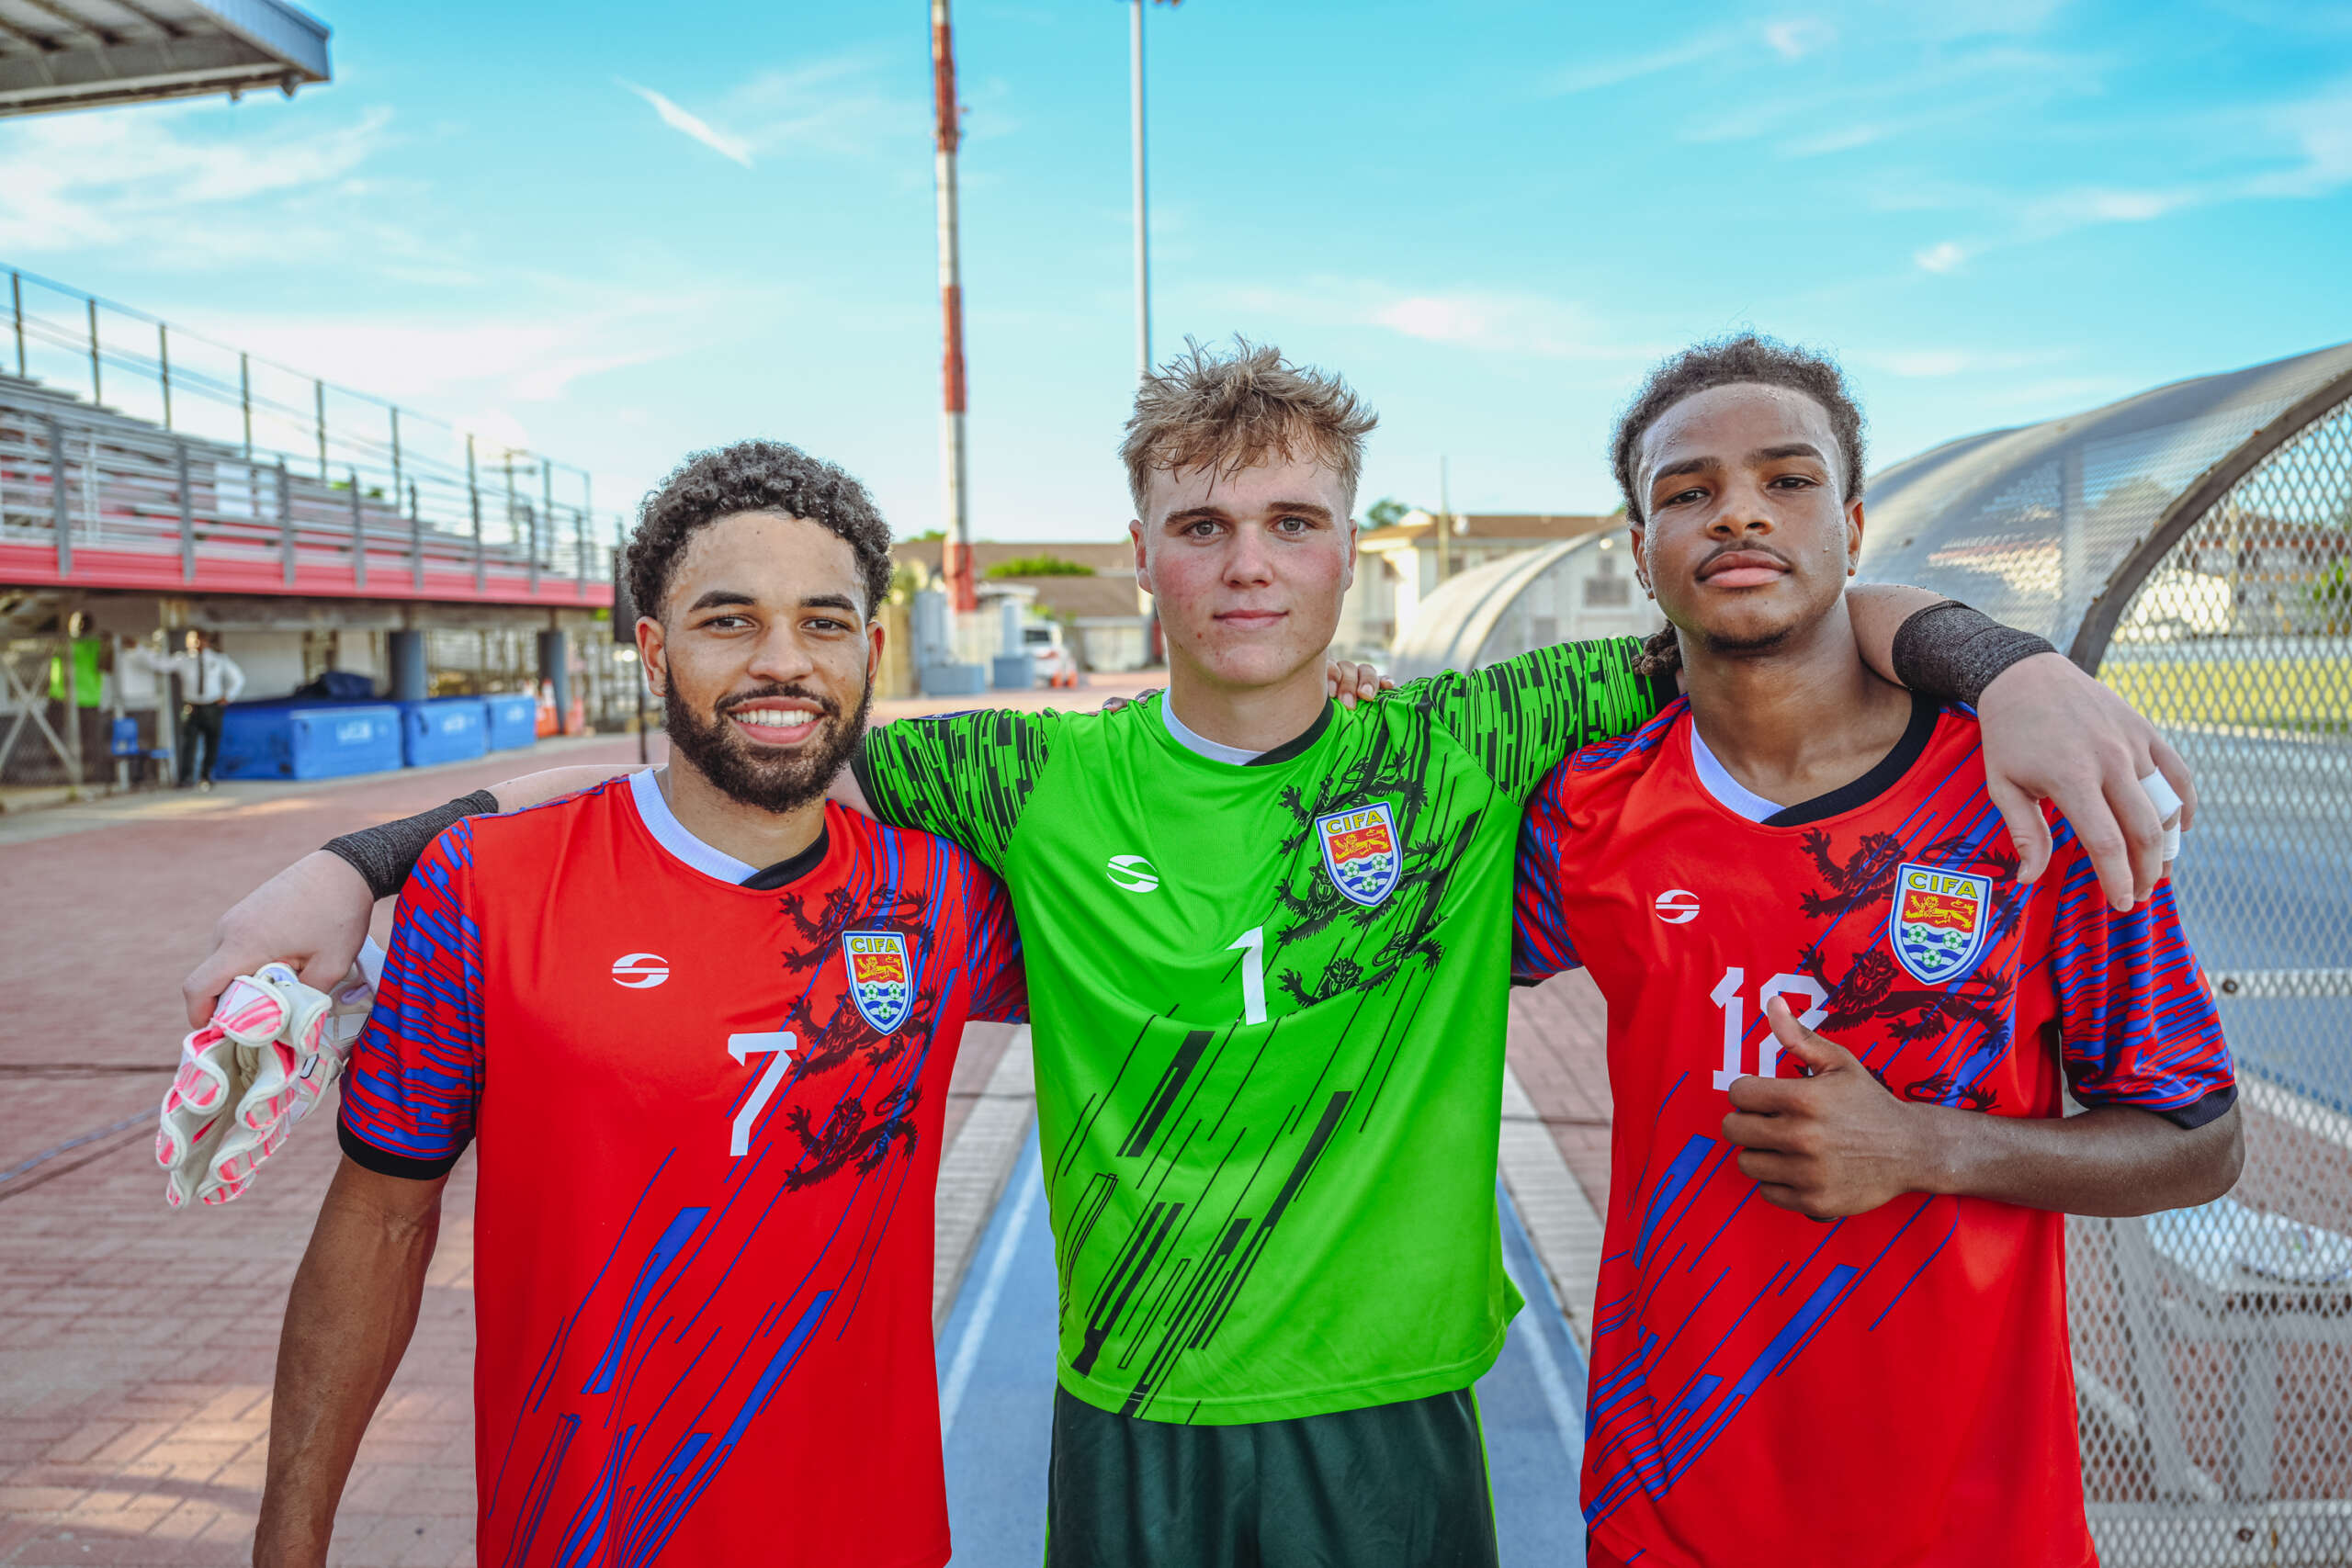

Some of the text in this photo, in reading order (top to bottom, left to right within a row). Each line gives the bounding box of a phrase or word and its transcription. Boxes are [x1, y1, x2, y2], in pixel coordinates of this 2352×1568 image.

[1326, 809, 1385, 834] CIFA
[1908, 872, 1978, 899] CIFA
[851, 938, 900, 953] CIFA
[1225, 925, 1268, 1026] 1
[728, 1031, 797, 1156] 7
